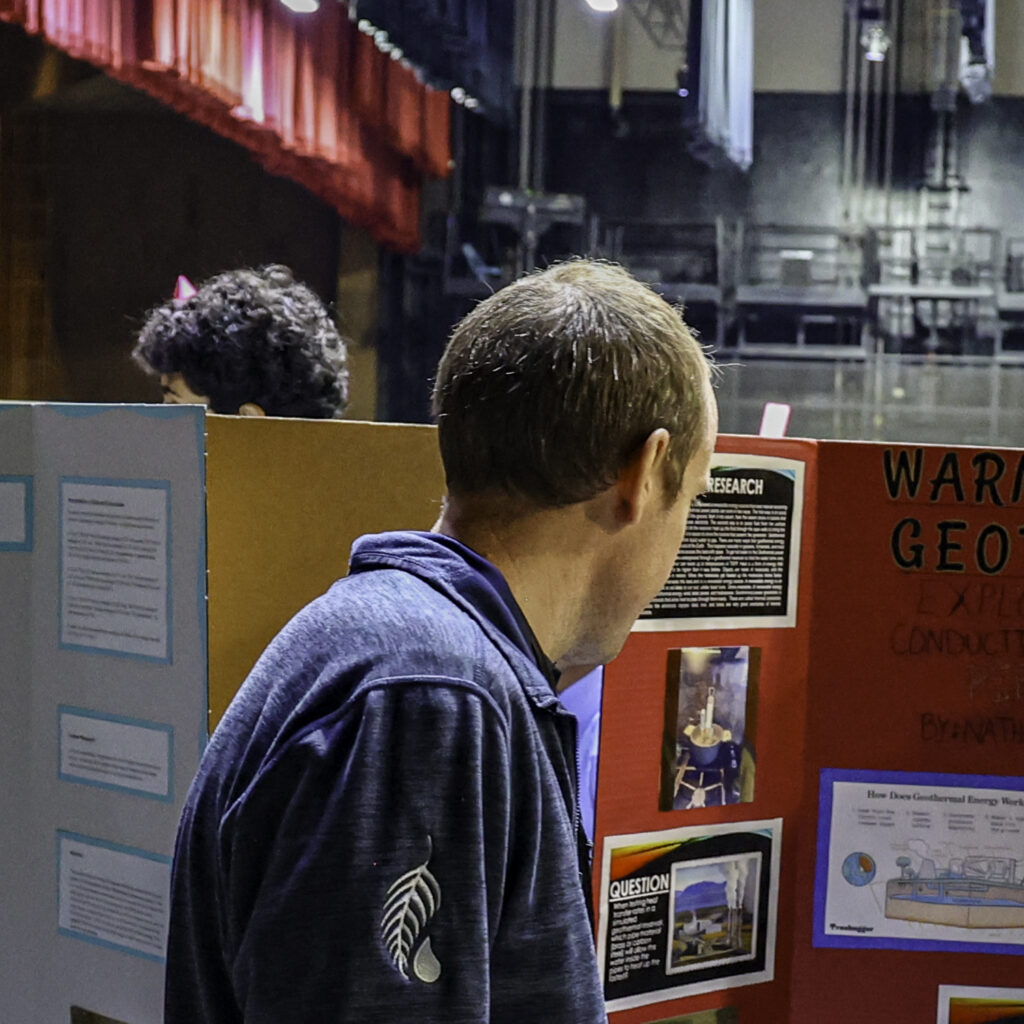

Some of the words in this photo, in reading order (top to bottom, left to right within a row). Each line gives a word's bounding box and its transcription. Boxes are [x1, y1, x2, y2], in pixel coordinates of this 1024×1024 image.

[709, 477, 764, 495] RESEARCH
[912, 792, 965, 804] Geothermal
[967, 794, 998, 807] Energy
[609, 873, 670, 899] QUESTION
